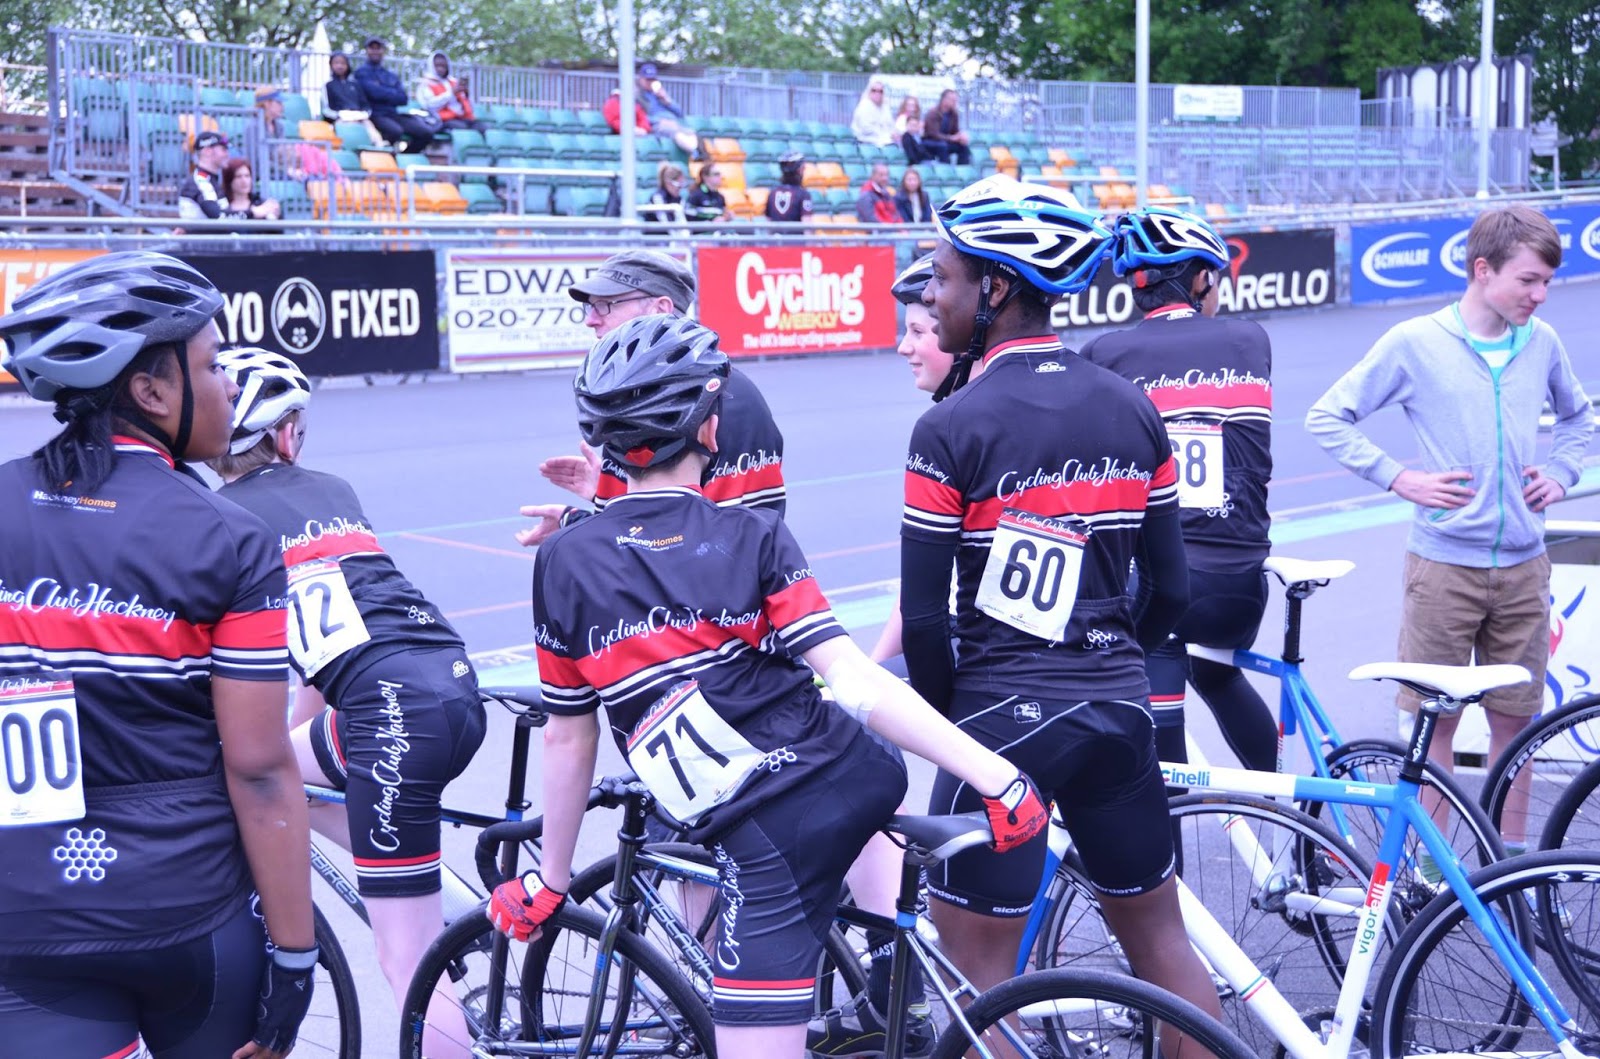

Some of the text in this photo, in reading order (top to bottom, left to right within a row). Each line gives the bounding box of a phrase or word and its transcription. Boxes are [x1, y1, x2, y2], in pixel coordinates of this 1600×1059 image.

[735, 251, 865, 330] Cycling
[1373, 248, 1430, 270] SCHWALBE
[331, 288, 421, 340] FIXED
[743, 333, 759, 349] The
[778, 312, 840, 331] WEEKLY
[1000, 538, 1067, 612] 60
[1, 707, 79, 795] 00
[645, 711, 731, 801] 71
[651, 903, 715, 981] ISLABIK
[1358, 882, 1385, 954] vigorelli
